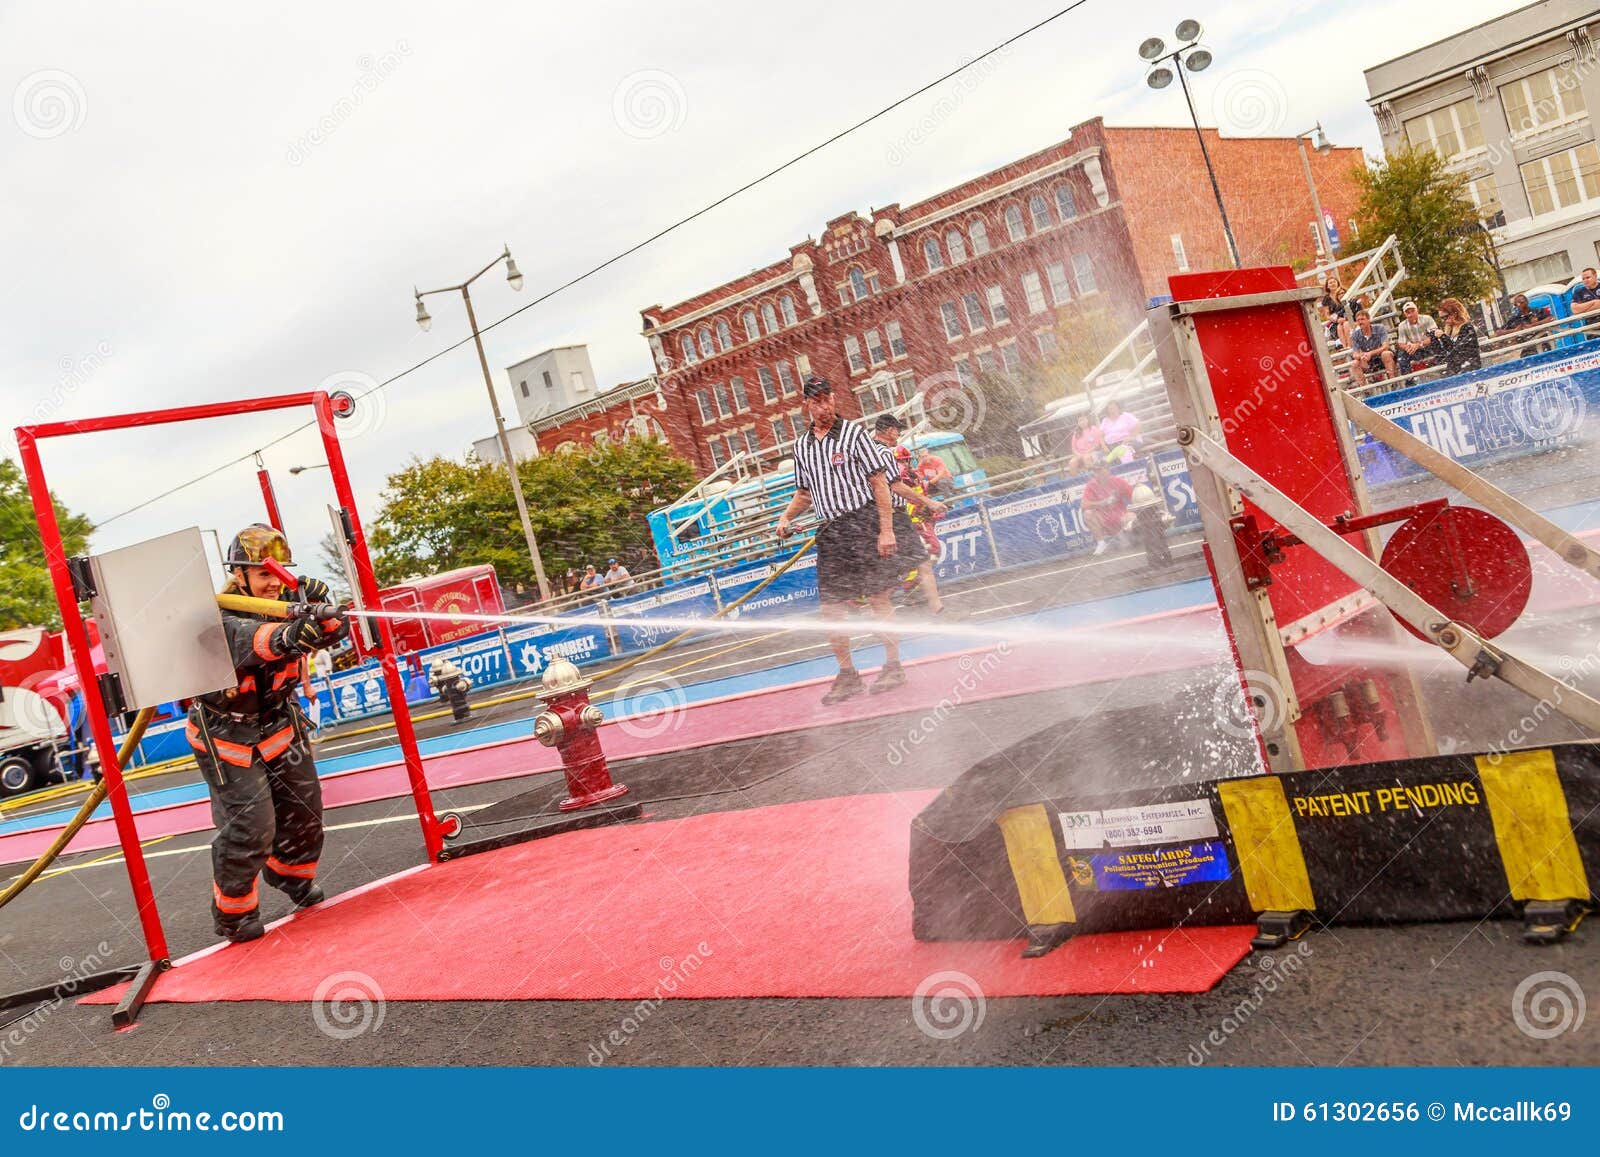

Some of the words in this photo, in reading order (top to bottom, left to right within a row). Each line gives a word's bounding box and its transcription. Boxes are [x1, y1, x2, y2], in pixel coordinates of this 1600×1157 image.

[1498, 373, 1530, 388] SCOTT
[1378, 405, 1402, 417] COTT
[743, 593, 794, 612] MOTOROLA
[542, 634, 597, 660] SUNBELT
[1294, 791, 1371, 817] PATENT
[1376, 781, 1480, 812] PENDING
[1103, 865, 1137, 873] Pollution
[1137, 860, 1178, 870] Prevention
[1179, 855, 1215, 866] Products
